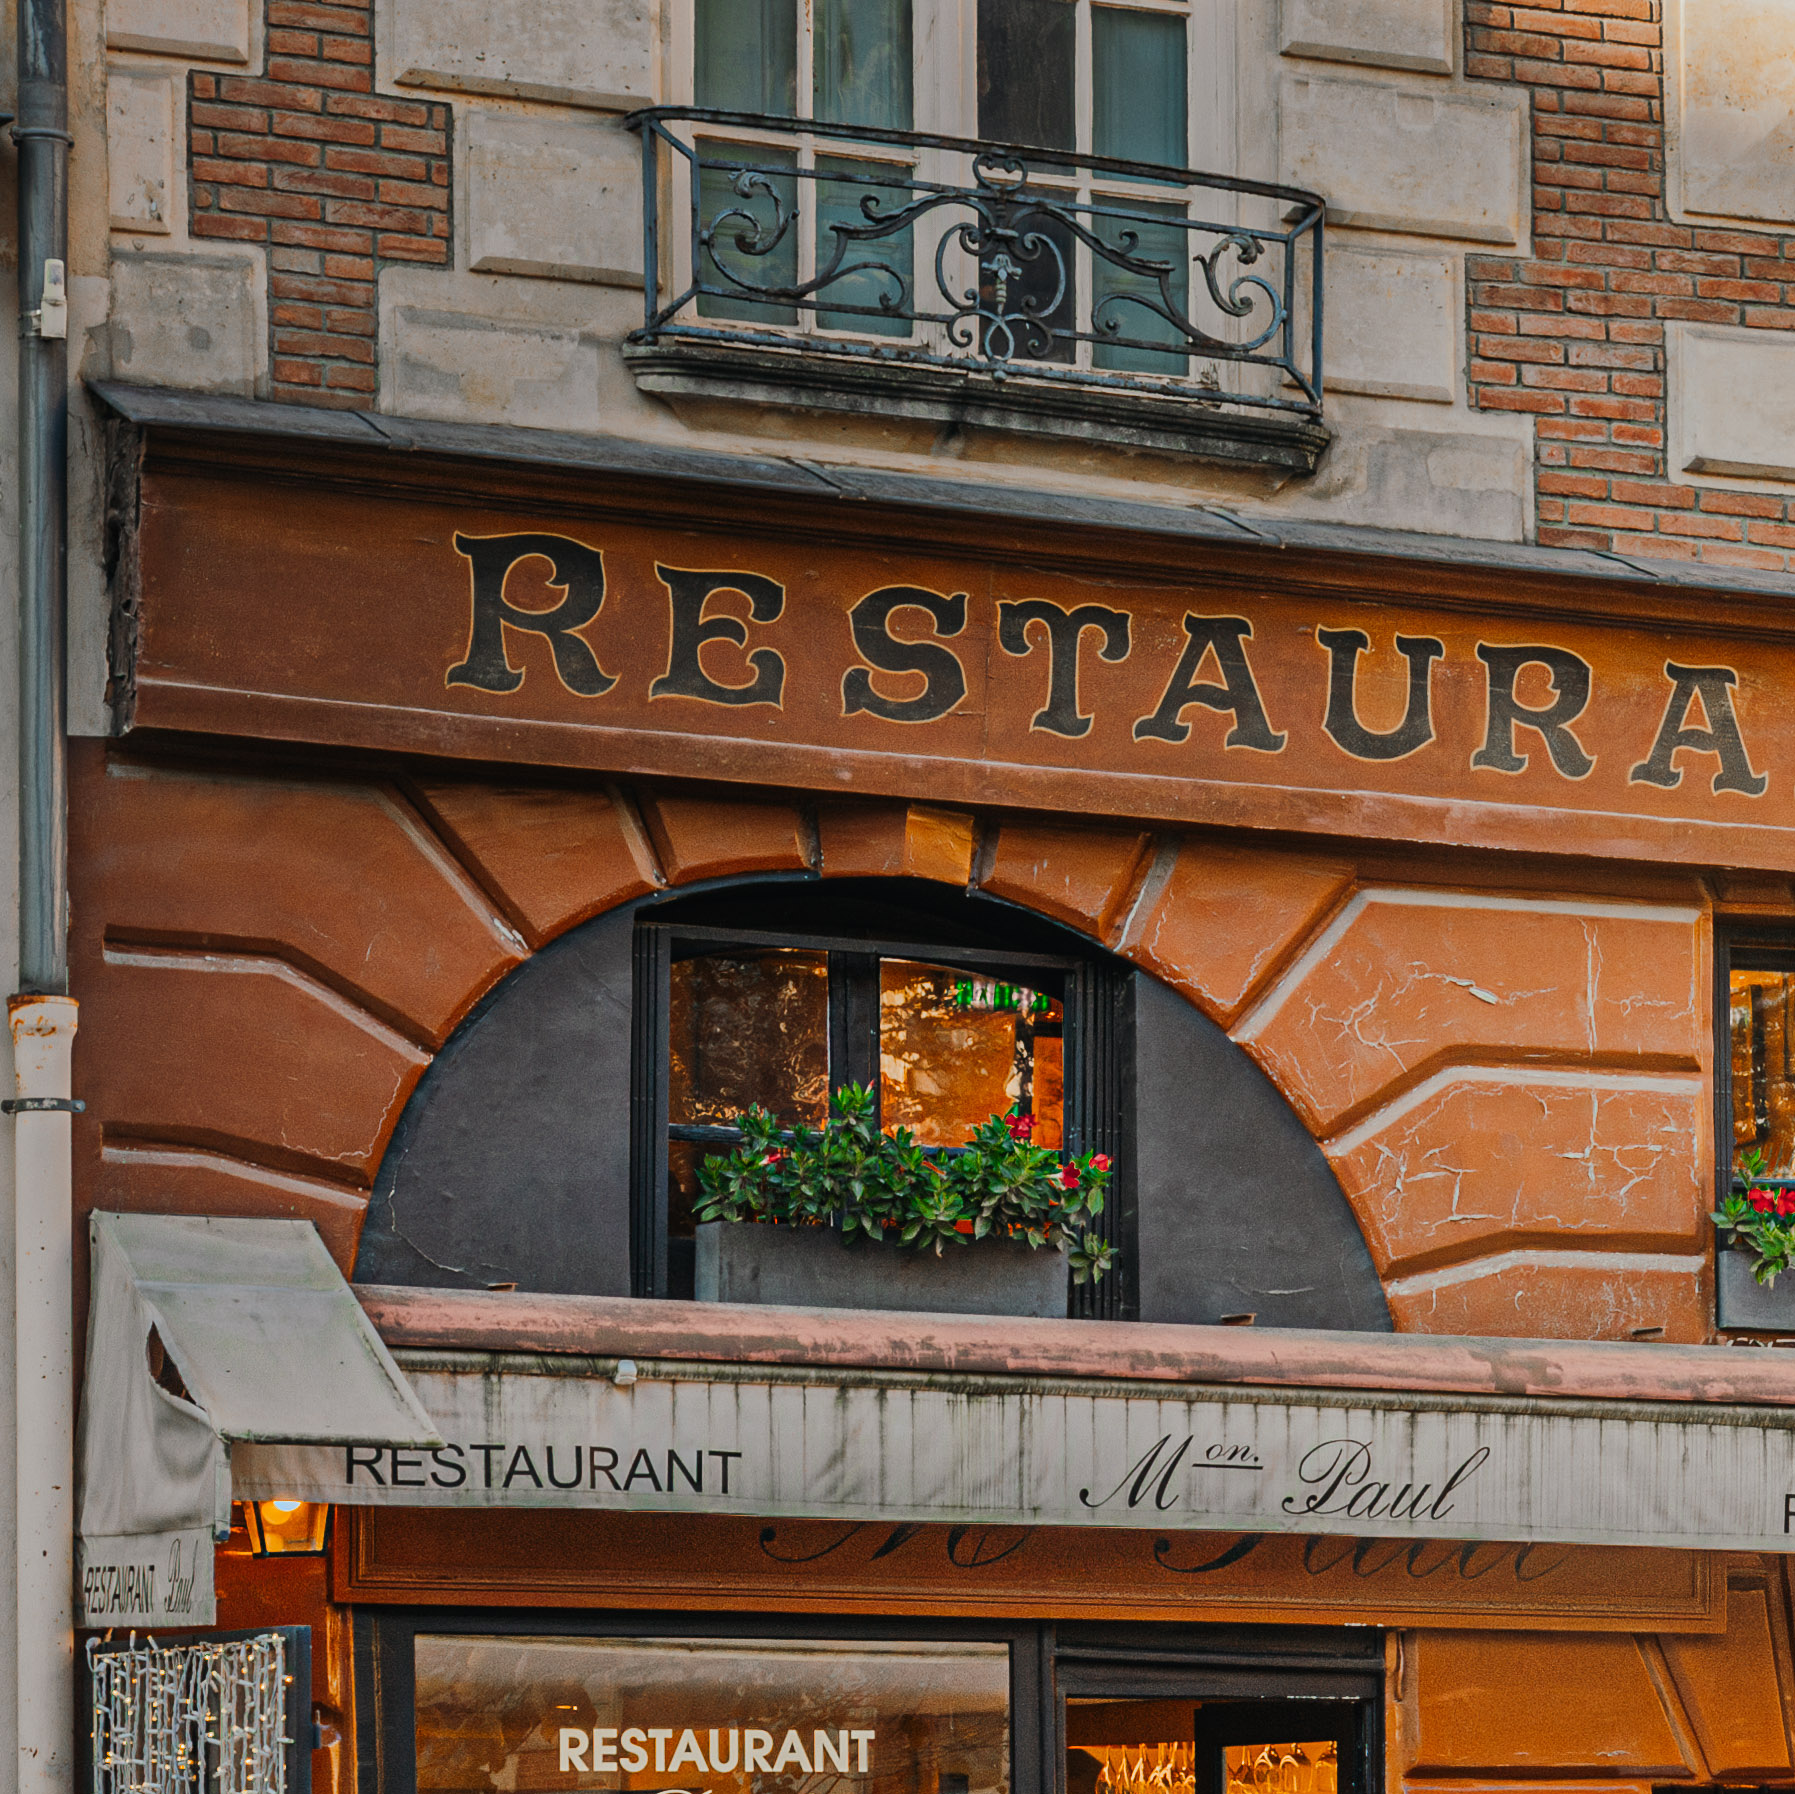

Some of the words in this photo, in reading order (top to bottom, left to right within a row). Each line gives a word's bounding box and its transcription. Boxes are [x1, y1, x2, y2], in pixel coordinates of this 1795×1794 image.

[345, 1443, 743, 1495] RESTAURANT
[1281, 1438, 1491, 1520] Paul
[84, 1565, 155, 1614] RESTAURANT
[558, 1728, 876, 1774] RESTAURANT
